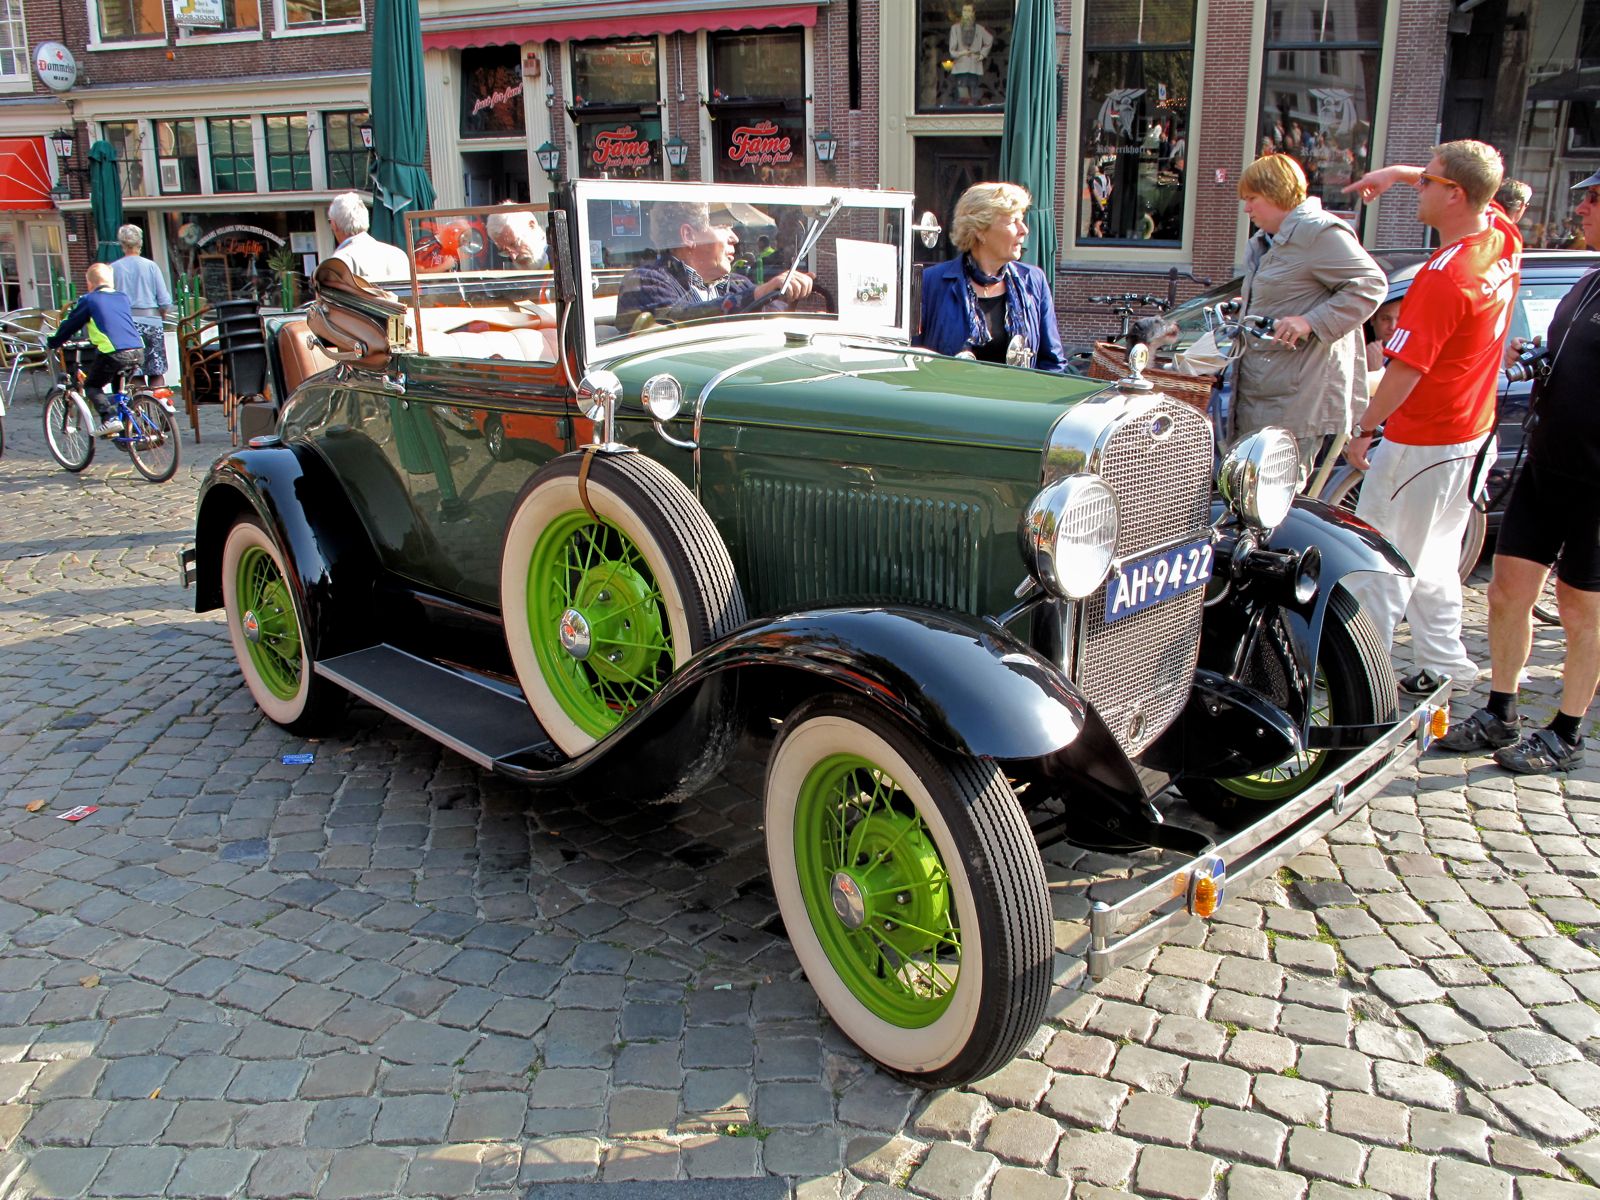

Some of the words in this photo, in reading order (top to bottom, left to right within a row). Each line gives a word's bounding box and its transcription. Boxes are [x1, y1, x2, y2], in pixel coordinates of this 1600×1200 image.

[593, 130, 650, 165] Fame
[728, 125, 791, 160] Fame
[1112, 544, 1213, 614] AH-94-22
